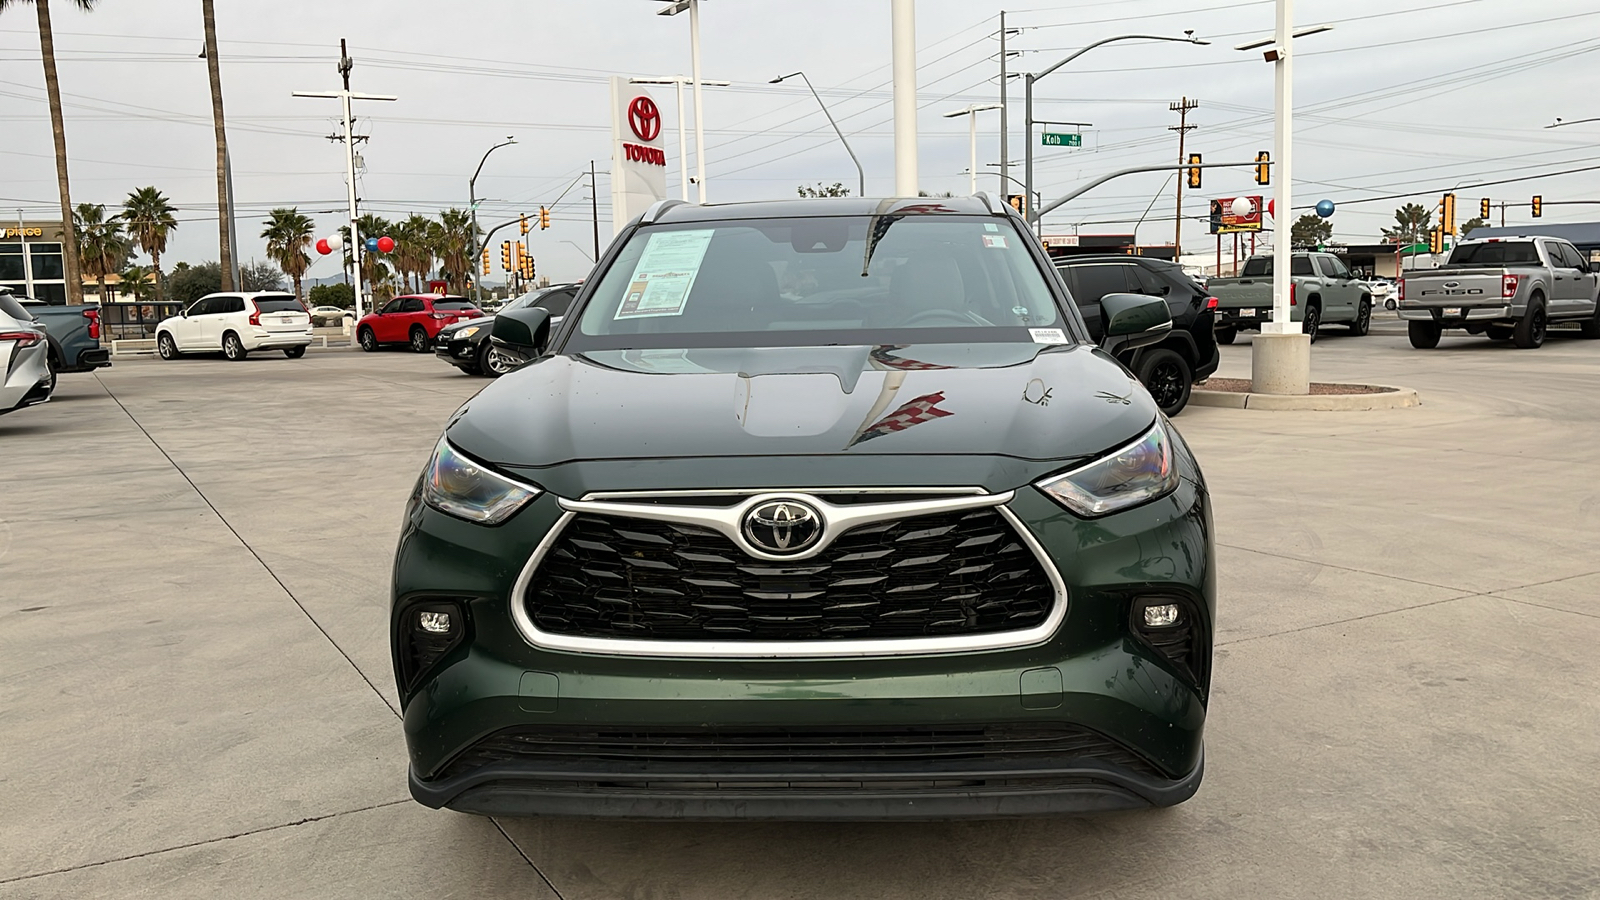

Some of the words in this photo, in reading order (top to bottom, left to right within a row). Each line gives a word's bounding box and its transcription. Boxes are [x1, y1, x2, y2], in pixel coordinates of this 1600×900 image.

[1046, 134, 1061, 145] Kolb
[623, 143, 666, 167] TOYOTA
[1421, 288, 1484, 296] F-150
